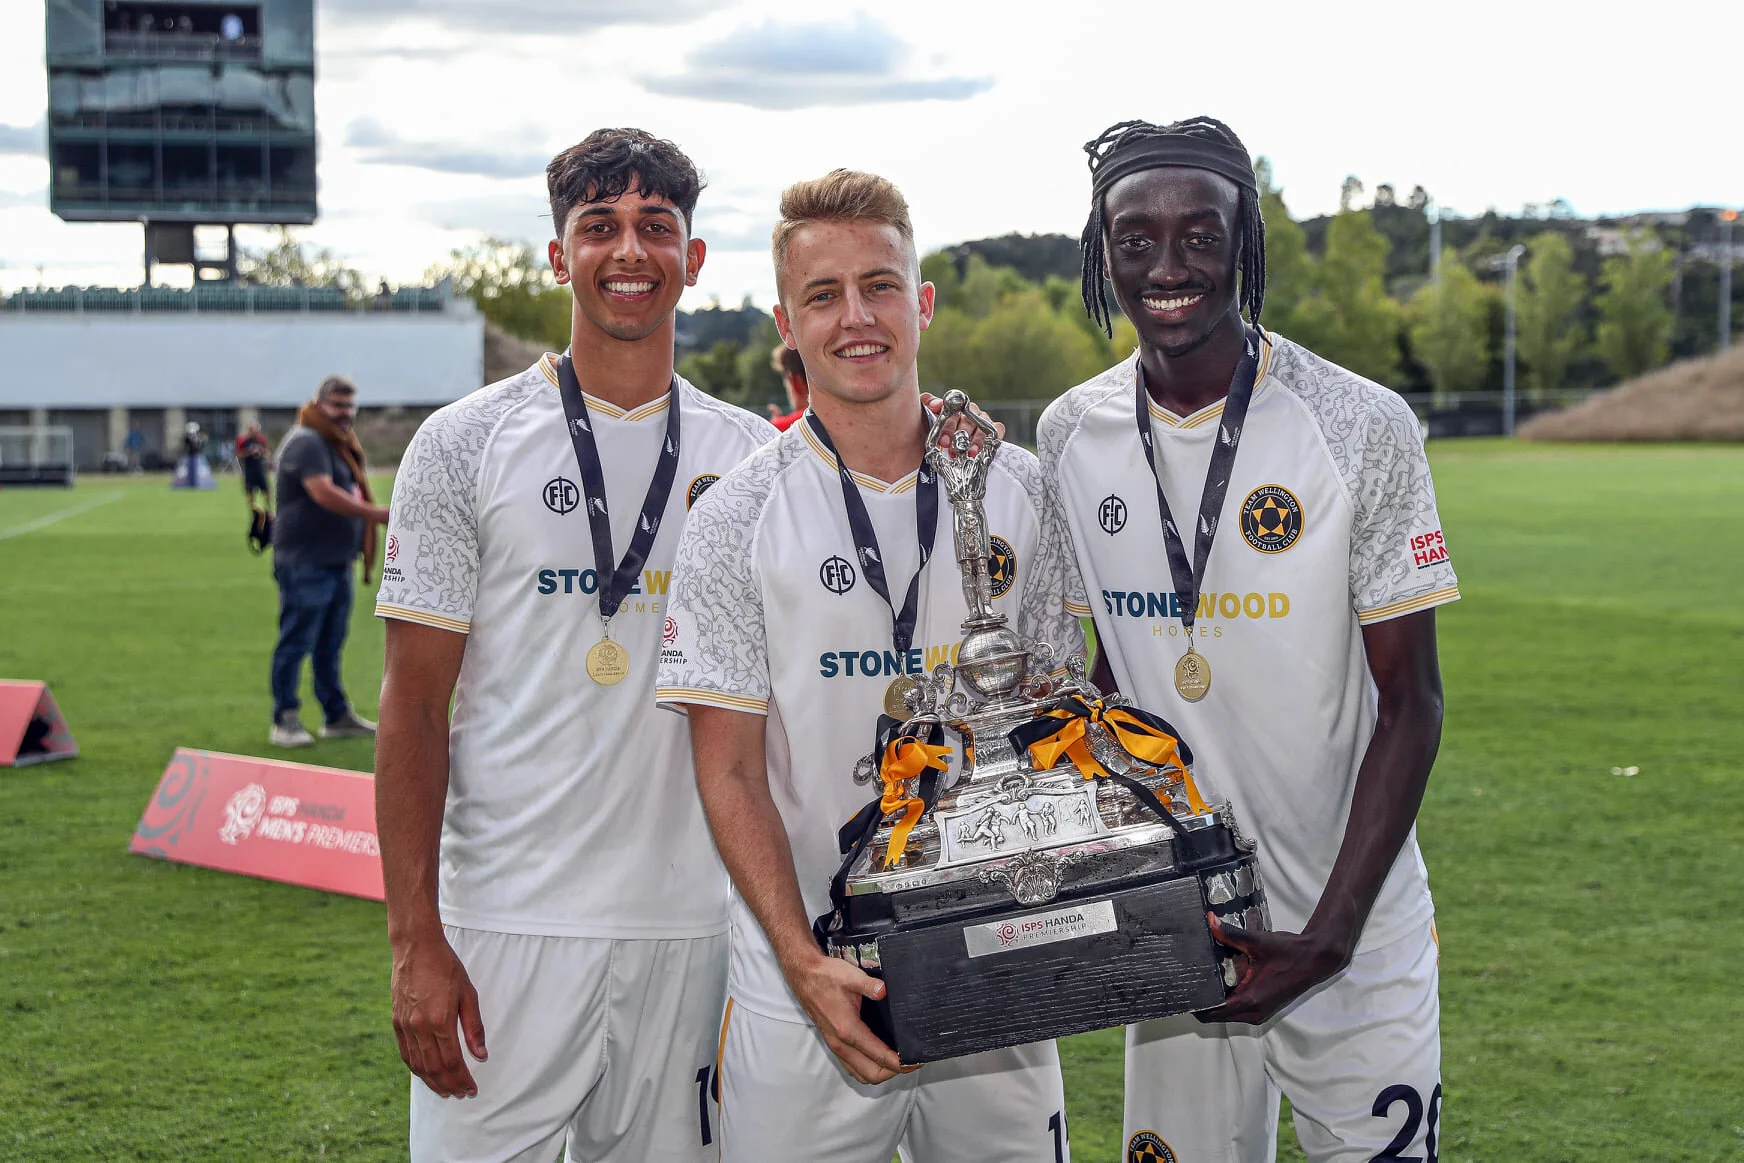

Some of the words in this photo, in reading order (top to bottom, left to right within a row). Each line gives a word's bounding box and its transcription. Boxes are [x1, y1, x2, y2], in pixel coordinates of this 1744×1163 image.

[1243, 494, 1258, 515] TEAM
[1257, 487, 1299, 513] WELLINGTON
[990, 537, 1014, 560] INGTON
[1245, 530, 1282, 551] FOOTBALL
[1282, 529, 1298, 546] CLUB
[1410, 530, 1444, 551] ISPS
[1021, 920, 1044, 933] ISPS
[1045, 913, 1085, 929] HANDA
[1023, 923, 1088, 941] PREMIERSHIP
